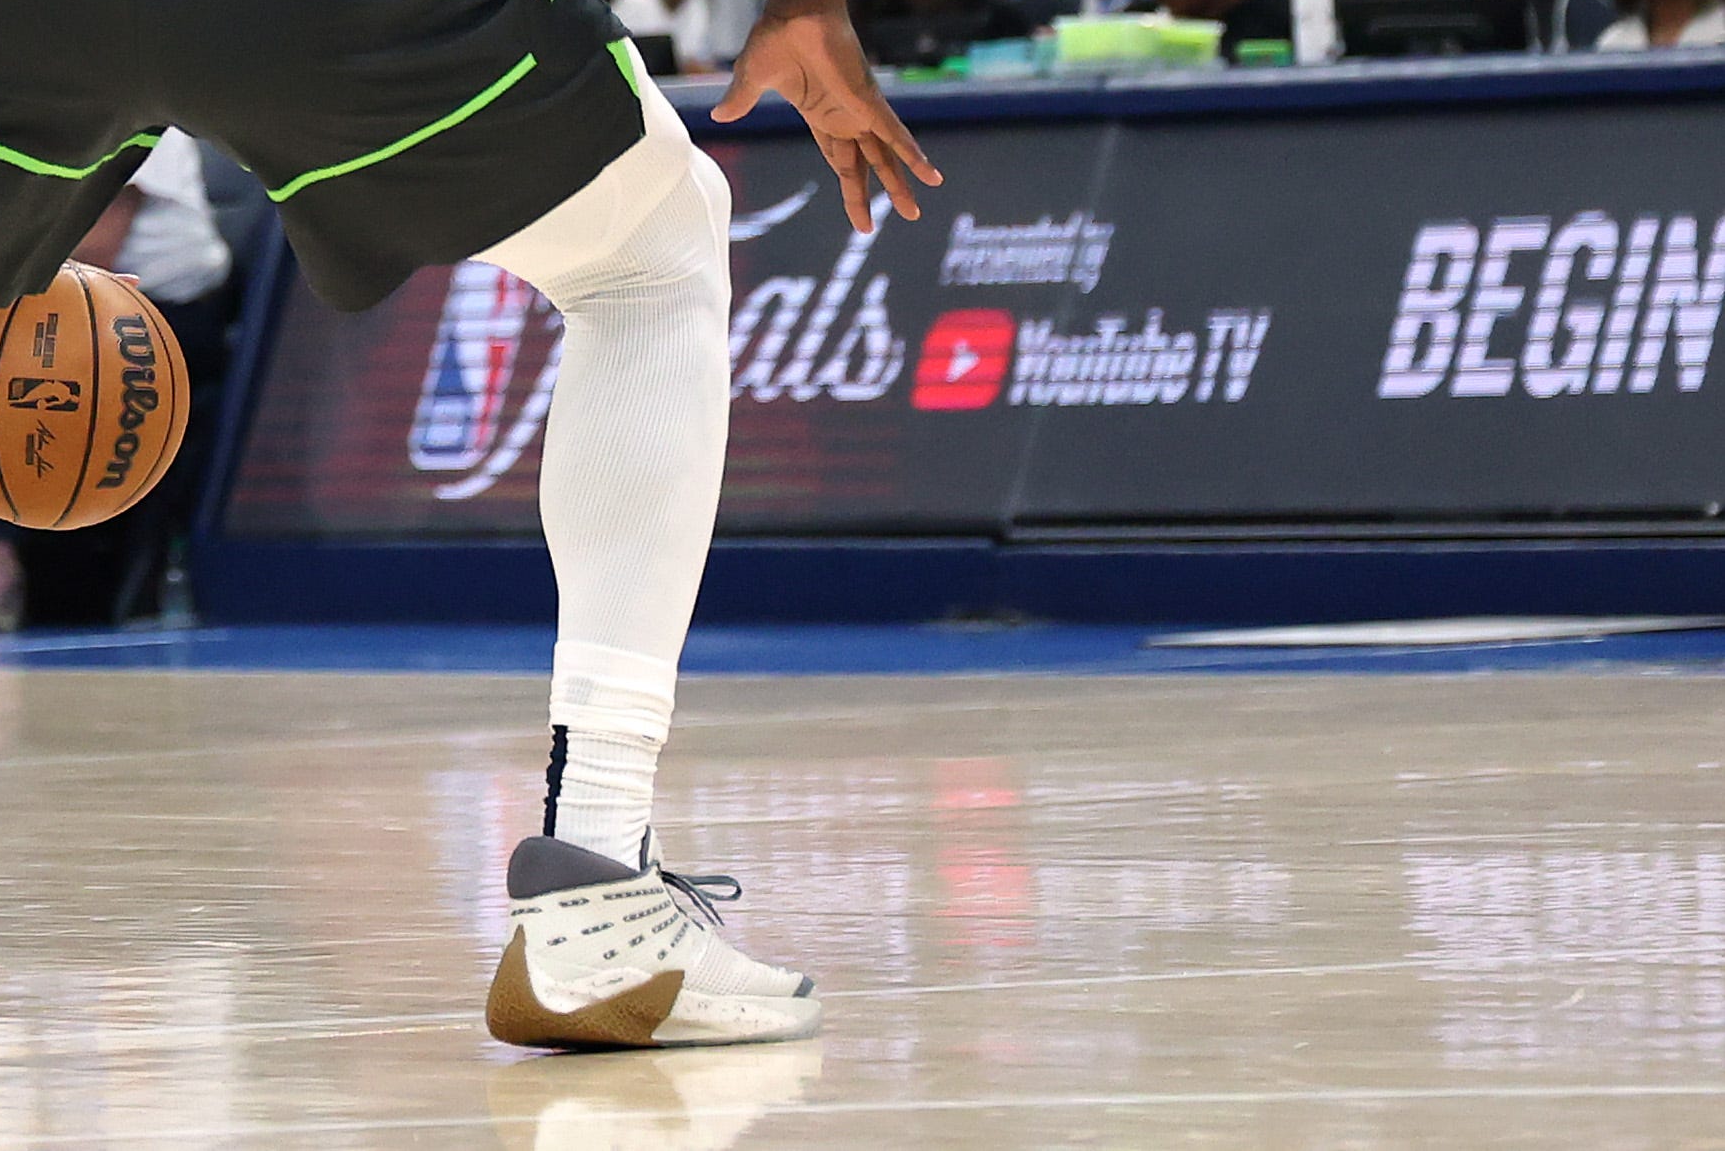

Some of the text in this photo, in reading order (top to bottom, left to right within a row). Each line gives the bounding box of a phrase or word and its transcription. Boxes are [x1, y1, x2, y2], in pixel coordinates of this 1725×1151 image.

[1195, 307, 1272, 404] TV
[1377, 210, 1725, 399] BEGIN
[96, 313, 160, 489] Wilson
